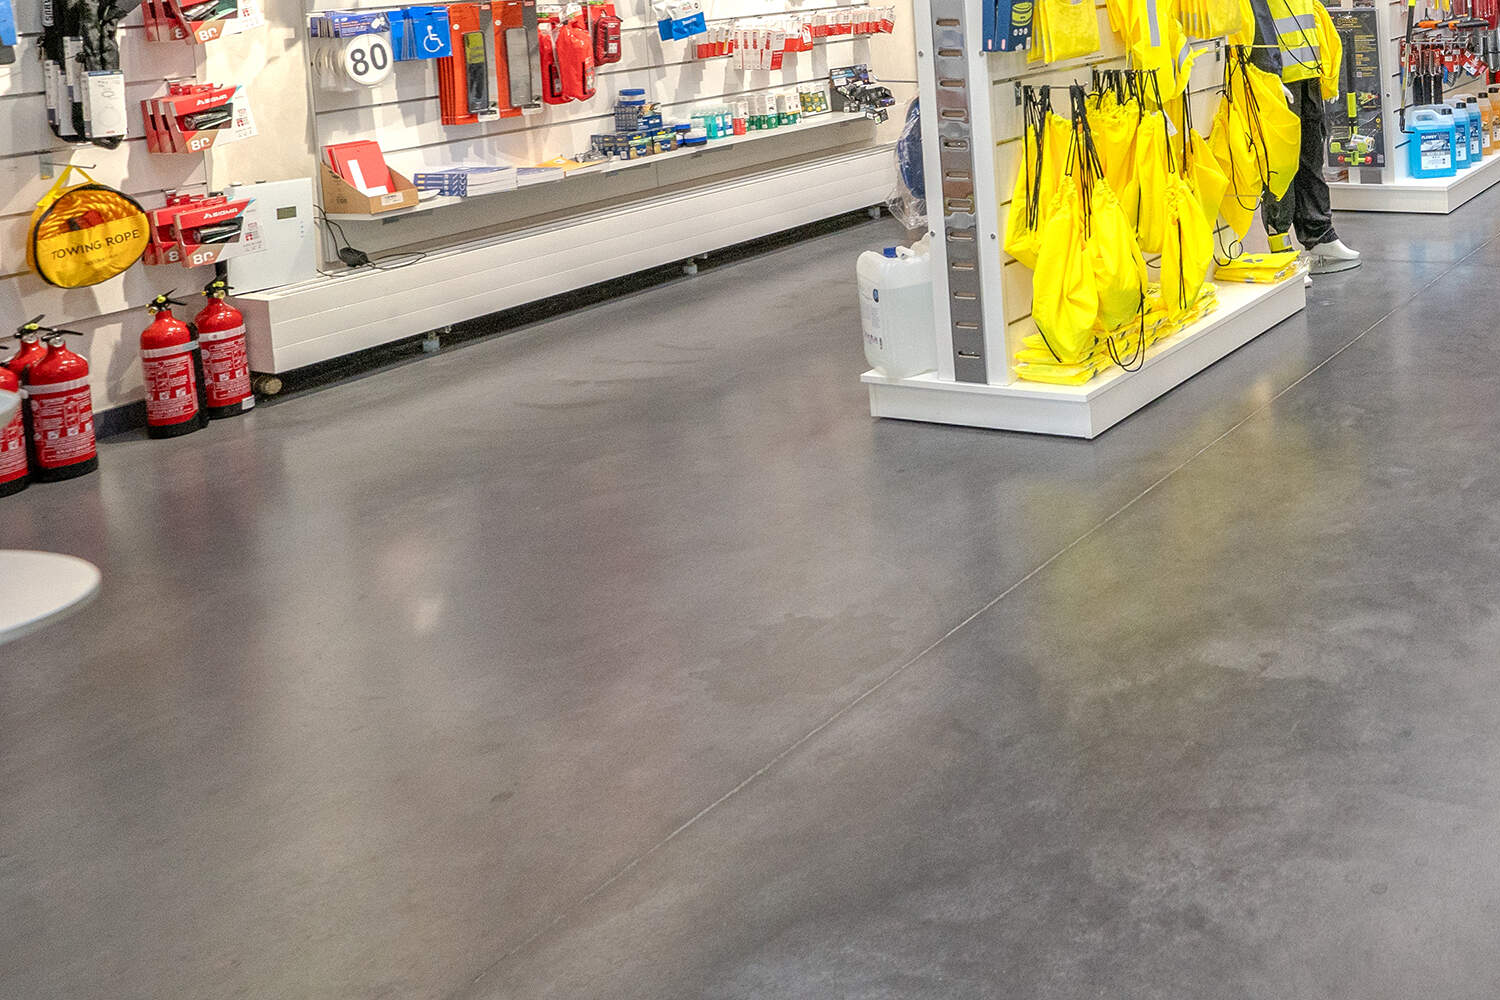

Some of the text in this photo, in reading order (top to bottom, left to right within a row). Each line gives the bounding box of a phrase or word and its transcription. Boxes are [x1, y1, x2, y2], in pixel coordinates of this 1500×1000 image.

[350, 42, 388, 77] 80
[346, 159, 388, 197] L
[51, 240, 102, 261] TOWING
[105, 229, 140, 247] ROPE
